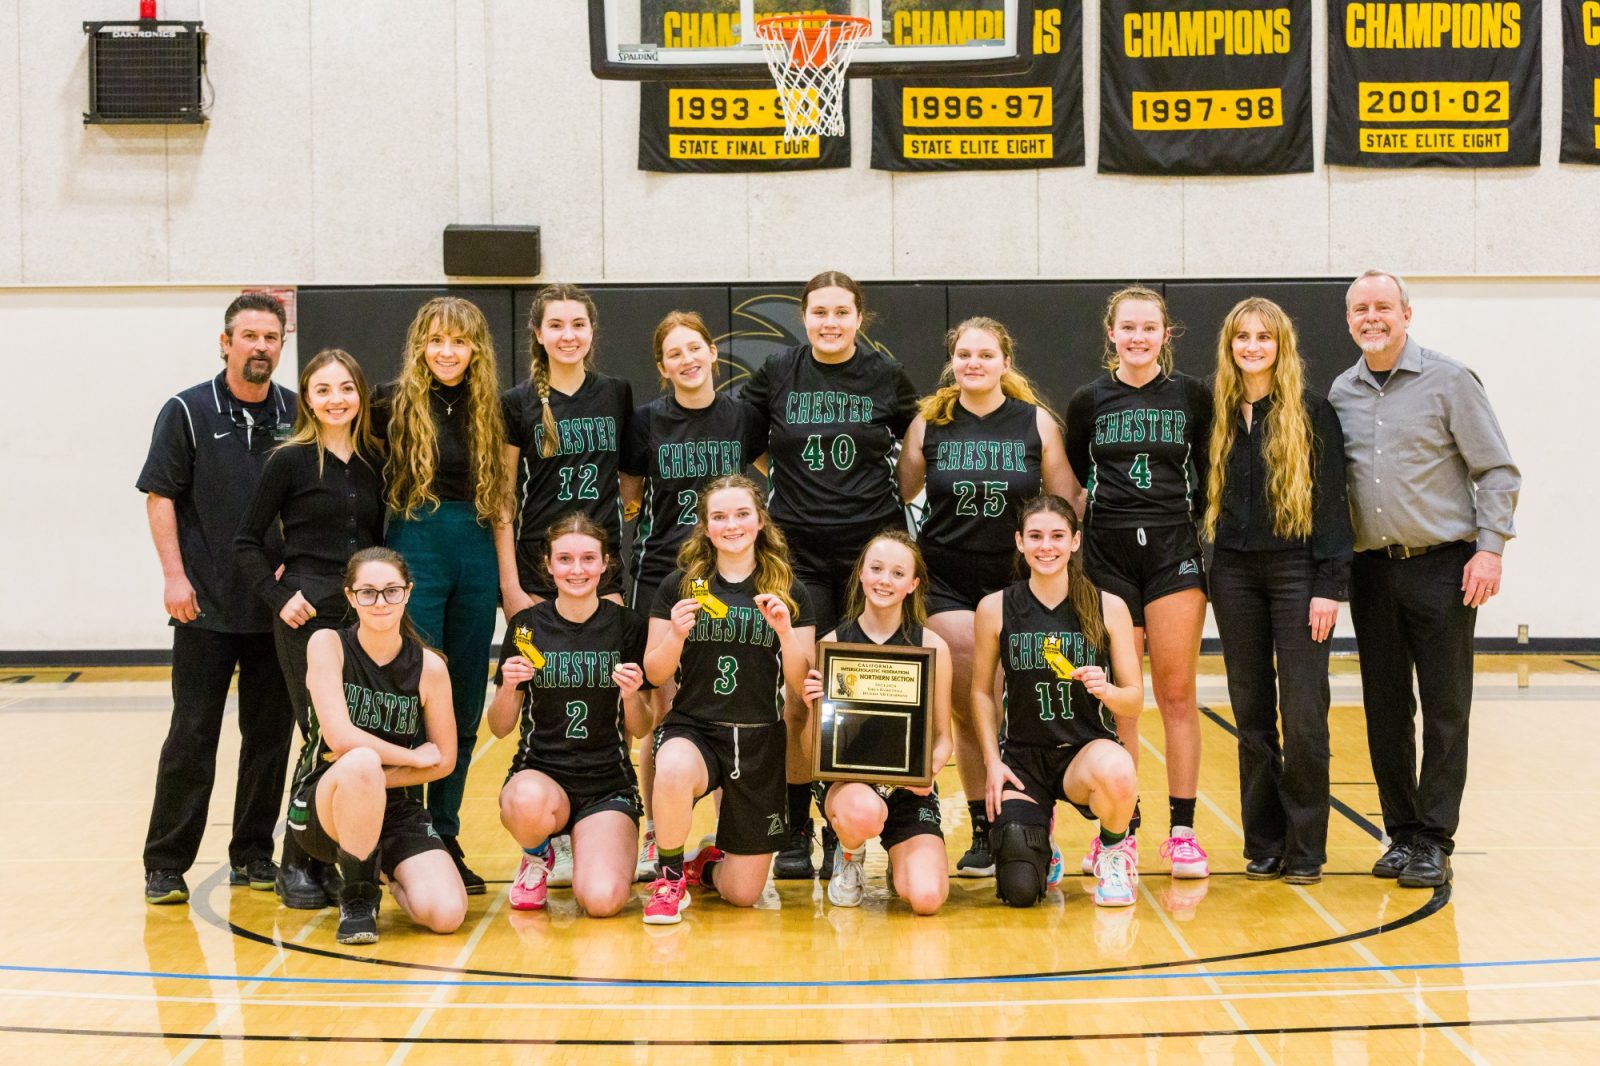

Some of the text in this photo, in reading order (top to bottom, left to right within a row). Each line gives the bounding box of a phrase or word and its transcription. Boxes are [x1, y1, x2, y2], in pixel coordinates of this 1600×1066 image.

[1123, 8, 1291, 58] CHAMPIONS
[1346, 2, 1521, 49] CHAMPIONS
[618, 51, 658, 61] SPALDING
[910, 95, 1044, 119] 1996-97
[1140, 97, 1275, 123] 1997-98
[1367, 90, 1502, 114] 2001-02
[679, 140, 809, 155] STATE FINAL FOUR
[911, 139, 1046, 154] STATE ELITE EIGHT
[1366, 133, 1502, 148] STATE ELITE EIGHT
[786, 391, 873, 424] CHESTER
[1095, 409, 1186, 445] CHESTER
[658, 440, 741, 479] CHESTER
[802, 434, 857, 471] 40
[936, 439, 1027, 473] CHESTER
[558, 463, 599, 501] 12
[1129, 453, 1151, 489] 4
[953, 481, 1009, 517] 25
[713, 656, 739, 696] 3
[344, 682, 420, 735] HESTER
[1035, 681, 1074, 721] 11
[566, 700, 588, 739] 2
